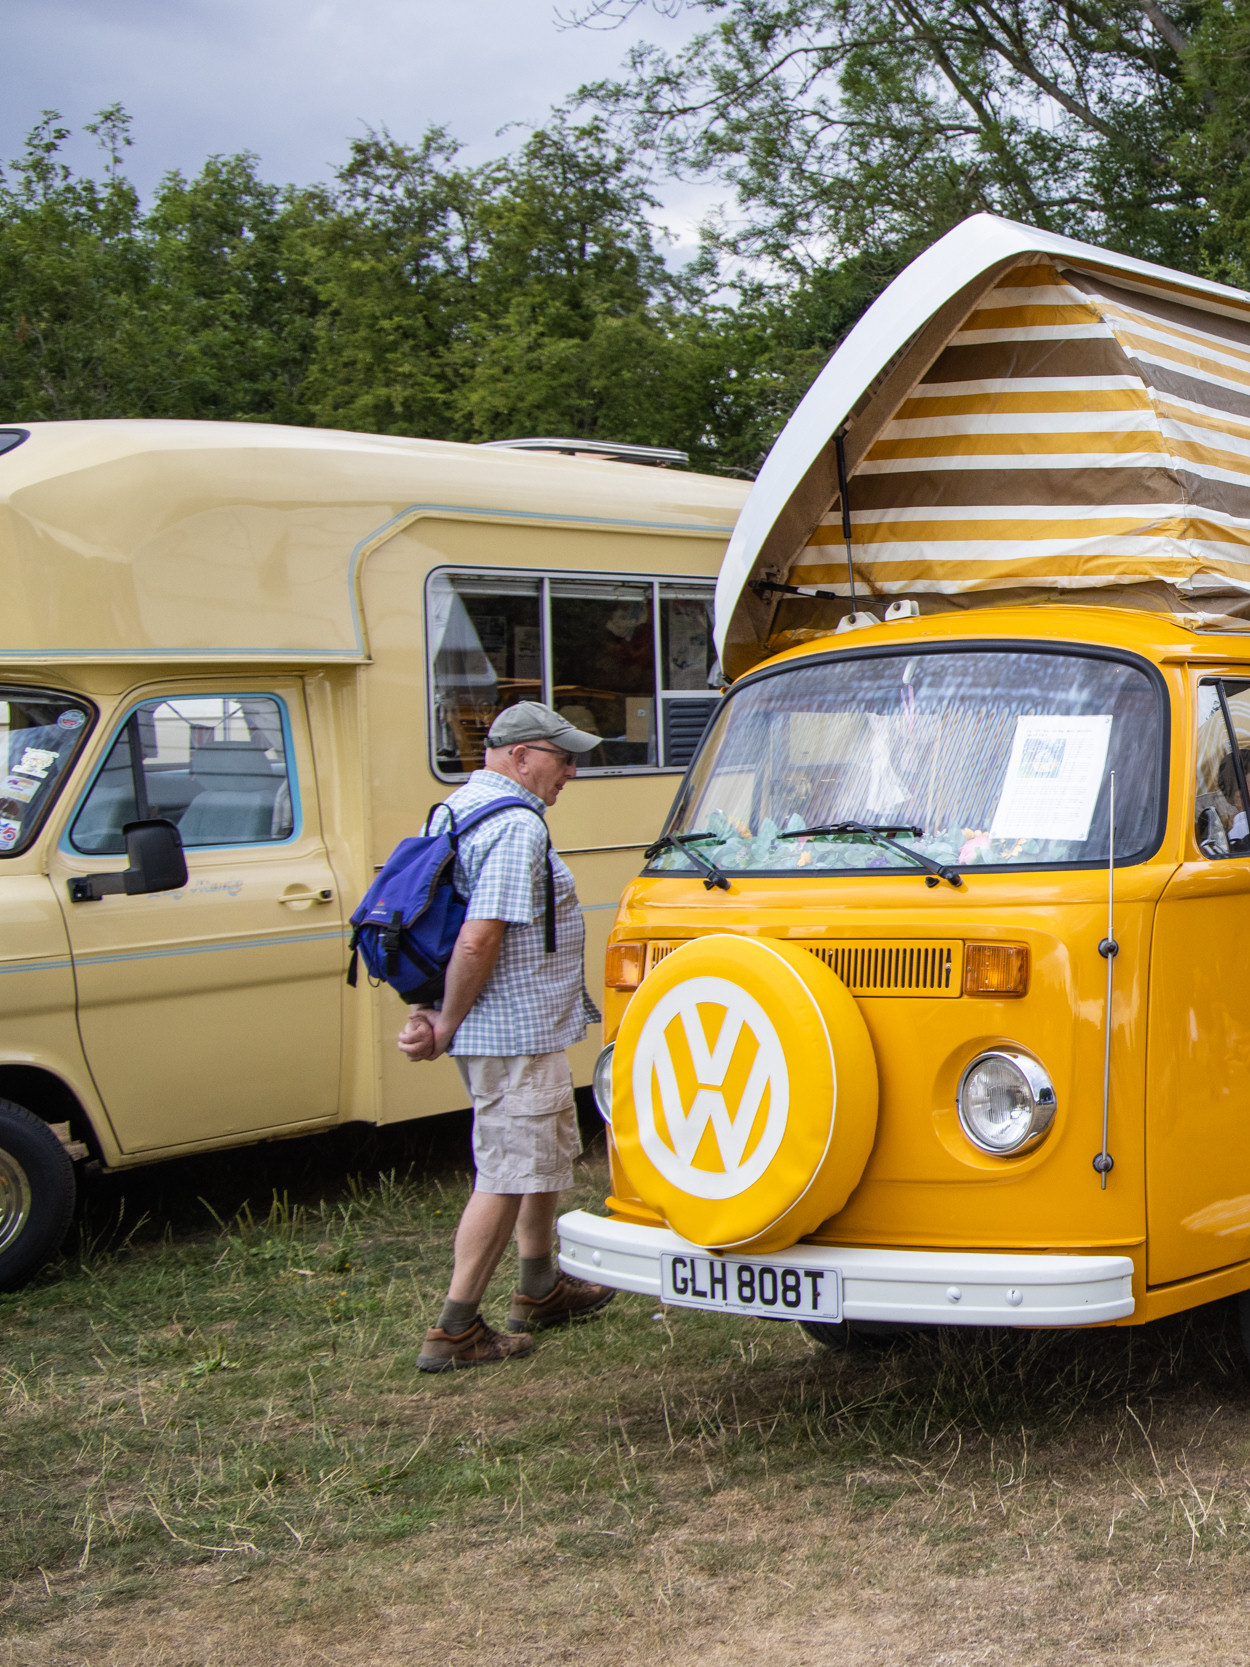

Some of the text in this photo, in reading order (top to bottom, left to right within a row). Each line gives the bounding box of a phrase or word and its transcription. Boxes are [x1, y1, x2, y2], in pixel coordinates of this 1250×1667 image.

[642, 989, 780, 1185] VW
[671, 1257, 825, 1310] GLH 808T
